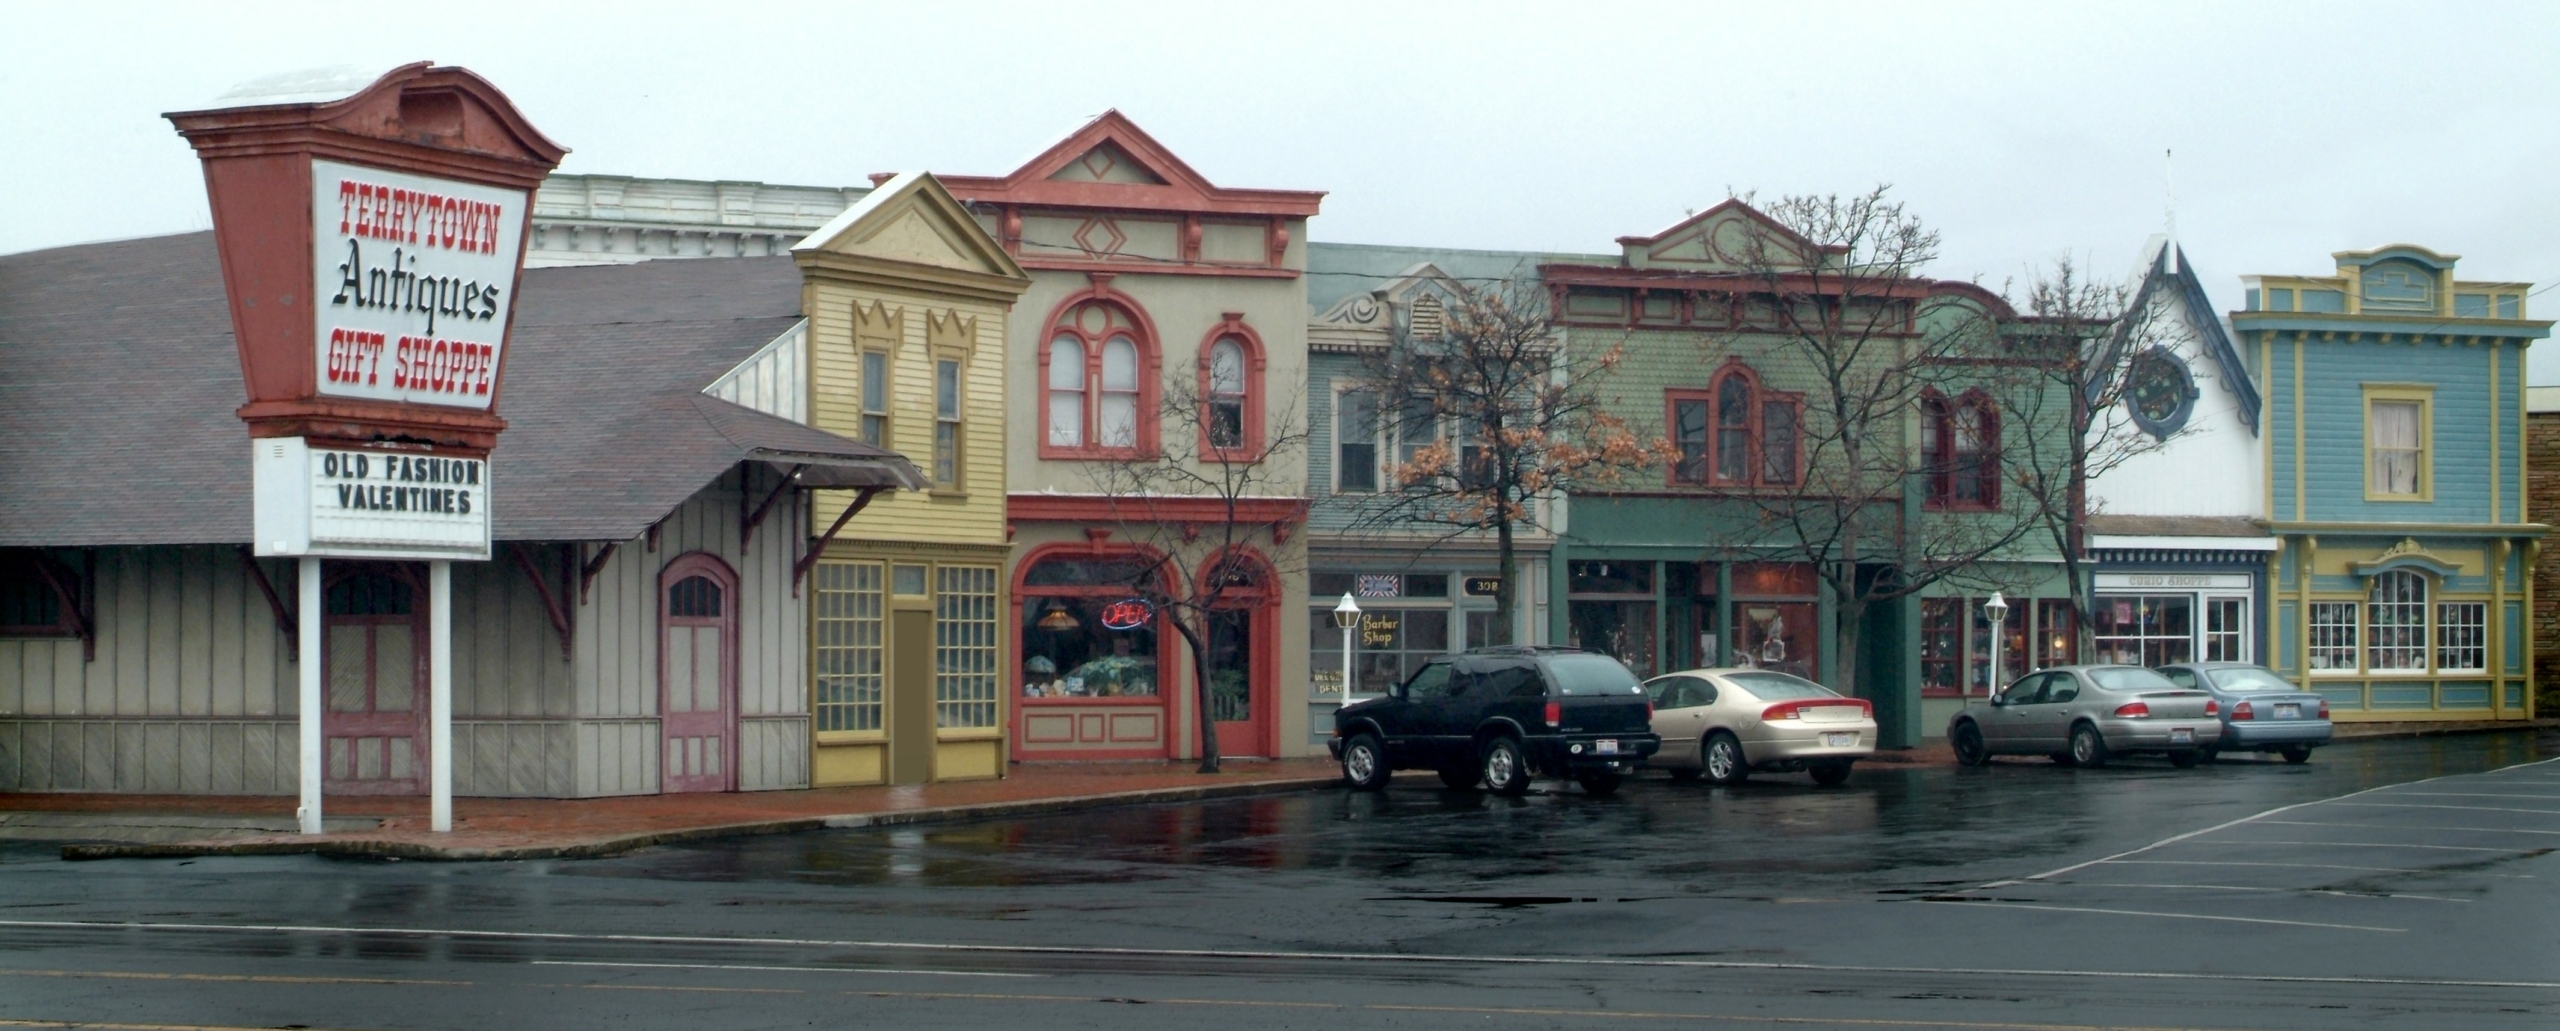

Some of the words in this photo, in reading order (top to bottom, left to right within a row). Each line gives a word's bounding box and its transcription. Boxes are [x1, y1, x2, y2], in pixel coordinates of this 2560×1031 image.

[340, 179, 502, 256] TERRYTOWN
[332, 238, 500, 336] Antiques
[327, 328, 385, 385] GIFT
[394, 335, 493, 395] SHOPPE
[324, 452, 369, 479] OLD
[386, 455, 479, 484] FASHION
[338, 484, 472, 514] VALENTINES
[1477, 581, 1498, 591] 308
[2129, 575, 2163, 586] CURIO
[2168, 575, 2211, 586] SHOPPE
[1102, 603, 1149, 624] OPEN
[1362, 613, 1399, 630] Barber
[1363, 631, 1392, 647] Shop
